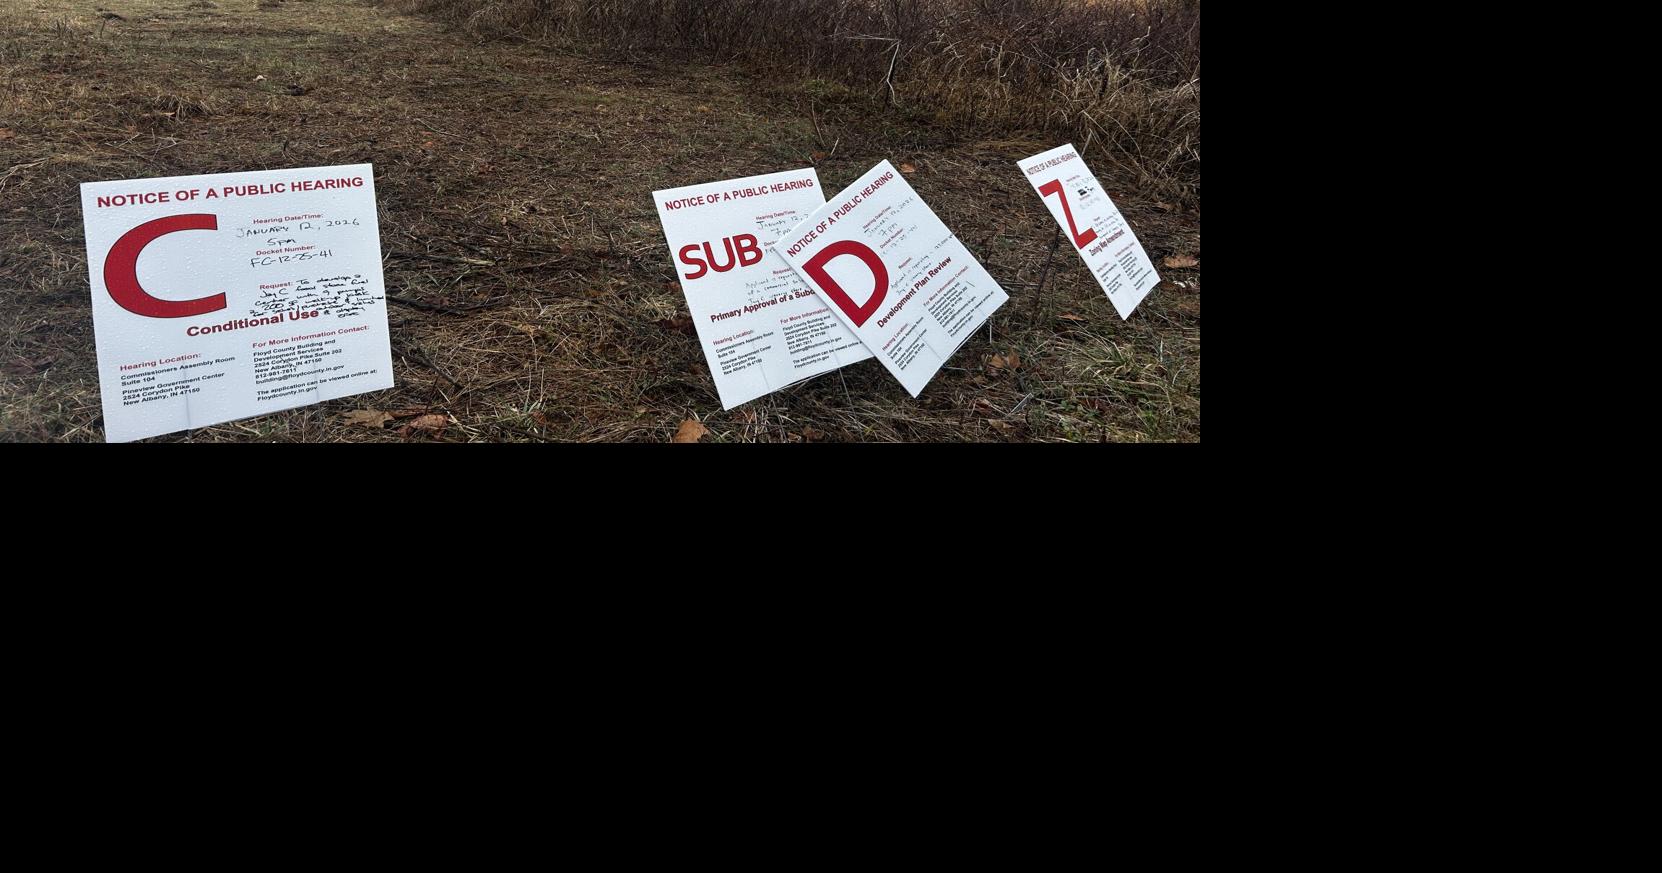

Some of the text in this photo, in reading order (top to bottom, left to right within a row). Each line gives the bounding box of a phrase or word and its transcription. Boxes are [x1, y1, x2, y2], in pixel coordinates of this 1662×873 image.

[97, 177, 363, 208] NOTICE OF A PUBLIC HEARING
[664, 178, 814, 211] NOTICE OF A PUBLIC HEARING
[284, 213, 324, 222] Date/Time:
[786, 170, 894, 258] NOTICE OF A PUBLIC HEARING
[1038, 179, 1098, 250] Z
[237, 224, 289, 238] JANUARY
[326, 217, 360, 229] 2026
[103, 213, 227, 318] C
[678, 233, 763, 280] SUB
[259, 281, 293, 290] Request:
[801, 240, 889, 328] D
[876, 288, 917, 328] Development
[914, 274, 931, 291] Plan
[928, 255, 952, 279] Review
[710, 308, 742, 325] Primary
[743, 298, 778, 315] Approval
[778, 294, 787, 304] of
[186, 313, 284, 337] Conditional
[289, 308, 319, 322] Use
[268, 337, 289, 346] More
[291, 330, 336, 342] Information
[338, 324, 370, 335] Contact:
[713, 336, 733, 346] Hearing
[254, 347, 324, 363] Development Services
[273, 346, 296, 354] County
[297, 341, 323, 350] Building
[120, 353, 201, 372] Hearing Location:
[120, 367, 177, 381] Commissioners
[180, 360, 214, 370] Assembly
[271, 356, 299, 366] Corydon
[122, 385, 155, 395] Pineview
[157, 377, 200, 388] Government
[142, 387, 172, 398] Corydon
[271, 383, 306, 394] application
[141, 393, 169, 403] Albany,
